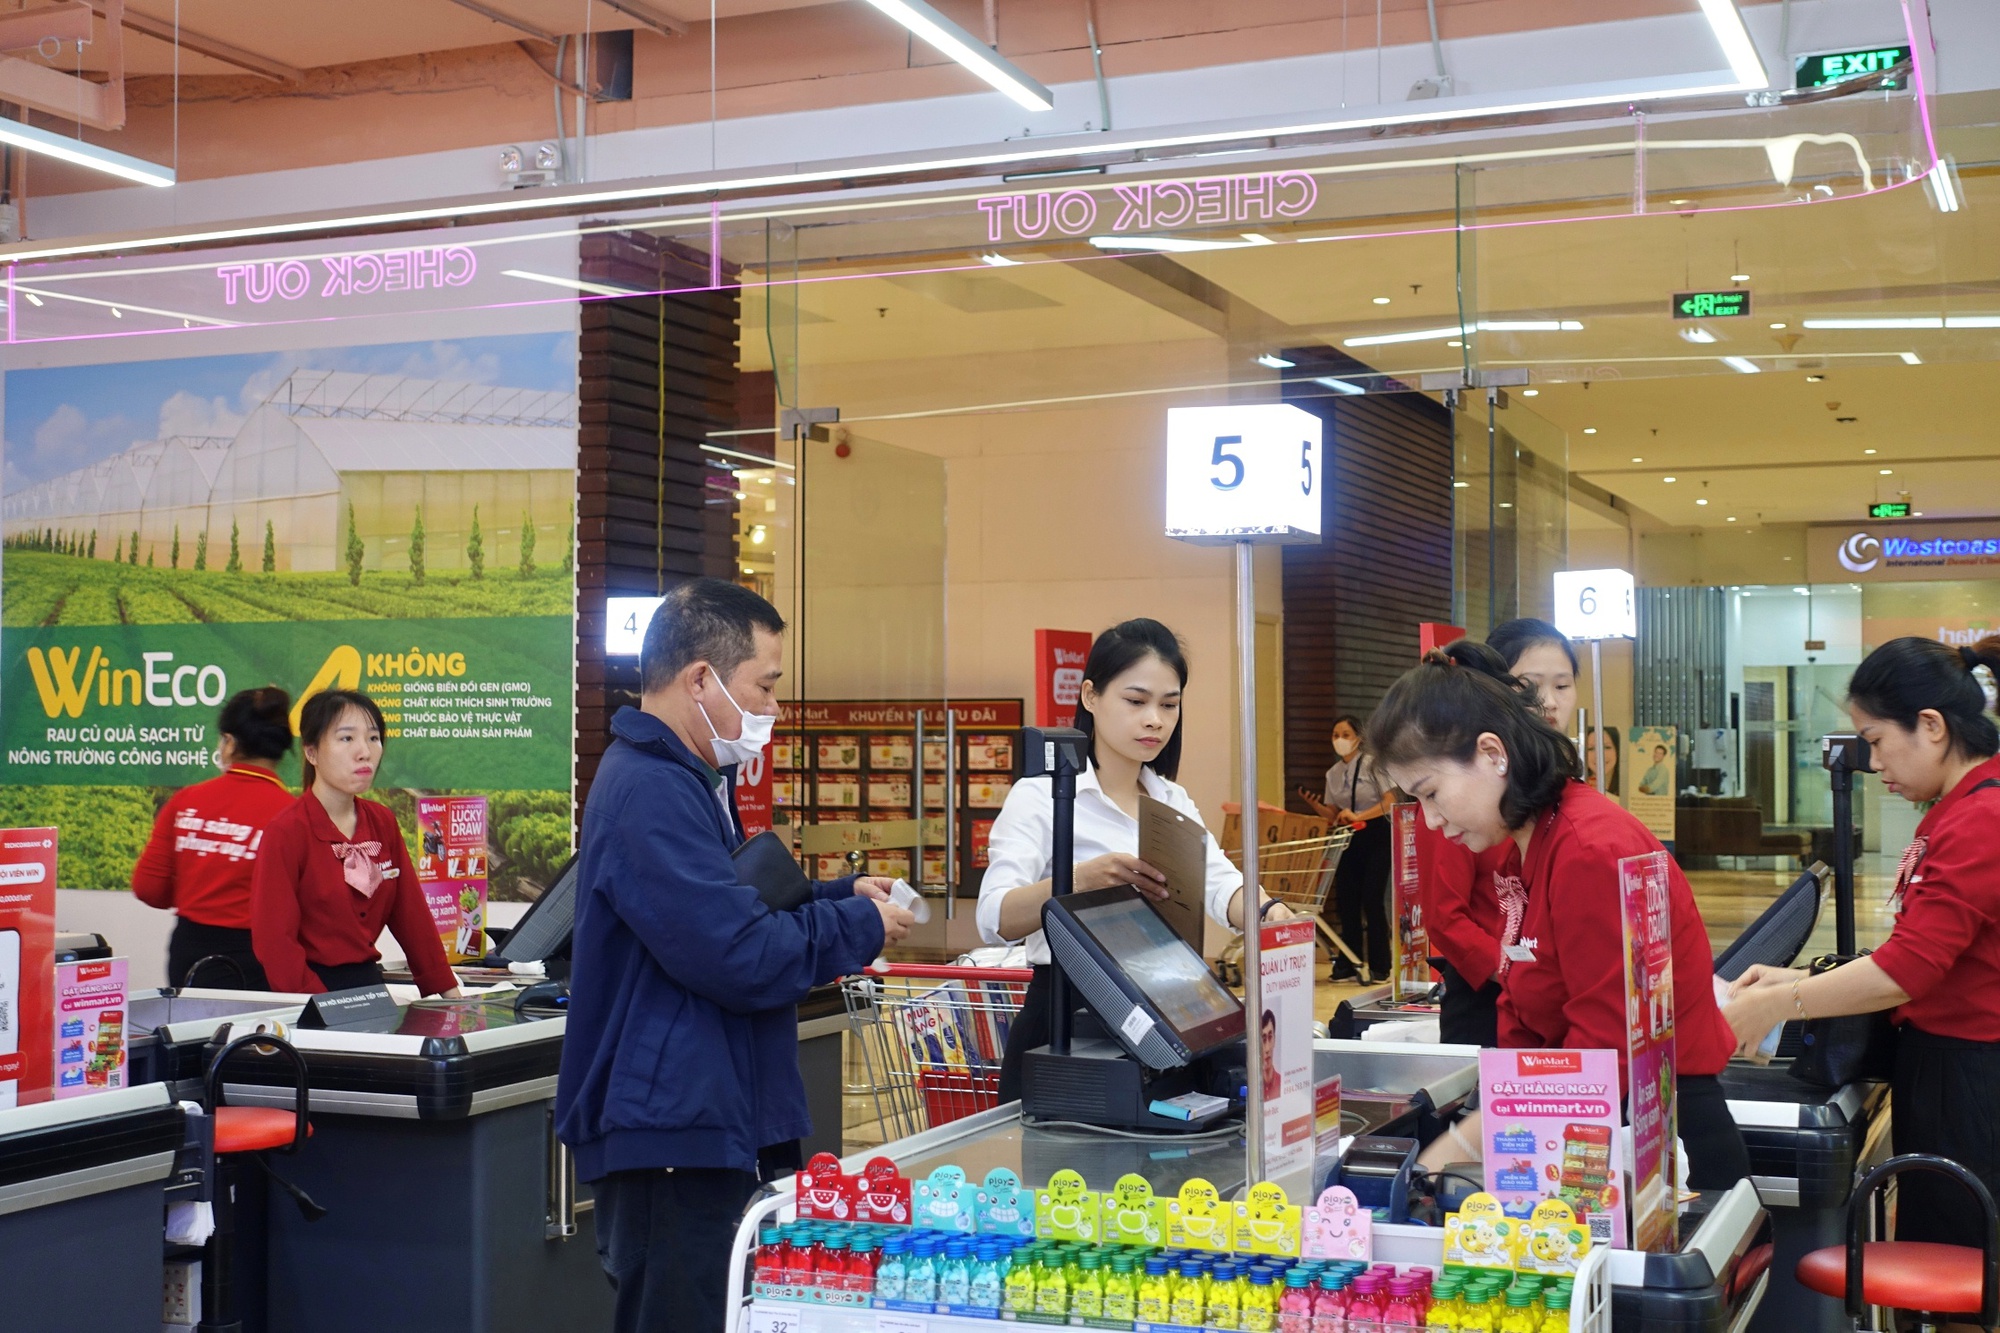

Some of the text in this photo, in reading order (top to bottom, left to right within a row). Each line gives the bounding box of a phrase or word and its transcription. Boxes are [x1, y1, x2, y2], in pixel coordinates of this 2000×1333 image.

[1822, 49, 1900, 77] EXIT
[1715, 305, 1740, 316] EXIT
[1210, 435, 1245, 491] 5
[1301, 440, 1312, 496] 5
[1579, 586, 1597, 615] 6
[623, 611, 638, 635] 4
[367, 646, 467, 677] KHÔNG
[27, 645, 227, 719] WinEco
[367, 681, 402, 693] KHÔNG
[403, 681, 434, 693] GIỐNG
[436, 681, 458, 692] BIẾN
[480, 682, 499, 692] GEN
[501, 682, 531, 693] (GMO)
[376, 697, 402, 708] HÔNG
[403, 697, 428, 708] CHẤT
[430, 697, 453, 708] KÍCH
[455, 697, 484, 708] THÍCH
[486, 697, 510, 708] SINH
[403, 711, 436, 723] THUỐC
[438, 711, 459, 723] BẢO
[460, 712, 473, 725] VỆ
[475, 711, 502, 725] THỰC
[503, 711, 522, 725] VẬT
[849, 705, 904, 722] KHUYẾN
[936, 710, 945, 722] &
[971, 708, 997, 722] ĐÃI
[47, 724, 206, 746] RAU CỦ QUẢ SẠCH TỪ
[403, 726, 427, 738] CHẤT
[430, 726, 450, 738] BẢO
[452, 726, 480, 739] QUẢN
[482, 726, 502, 738] SẢN
[503, 726, 532, 738] PHẨM
[8, 747, 51, 765] NÔNG
[54, 746, 116, 765] TRƯỜNG
[119, 747, 163, 765] CÔNG
[166, 747, 208, 768] NGHỆ
[420, 802, 447, 814] WinMart
[451, 809, 483, 823] LUCKY
[203, 817, 254, 842] sàng
[451, 822, 483, 837] DRAW
[419, 855, 432, 870] 01
[8, 867, 26, 879] VIÊN
[26, 868, 40, 878] WIN
[436, 892, 453, 906] sạch
[440, 904, 458, 916] xanh
[1261, 956, 1279, 976] QUẢN
[1280, 954, 1289, 973] LÝ
[62, 982, 123, 997] ĐẶT HÀNG NGAY
[1266, 976, 1301, 994] DUTY MANAGER
[73, 995, 122, 1008] winmart.vn
[907, 1006, 930, 1022] MUA
[1521, 1055, 1571, 1067] WinMart
[1492, 1081, 1607, 1096] ĐẶT HÀNG NGAY
[1645, 1079, 1657, 1107] sạch
[1495, 1101, 1606, 1114] tại winmart.vn
[1635, 1104, 1661, 1137] Sống xanh
[771, 1320, 788, 1333] 32
